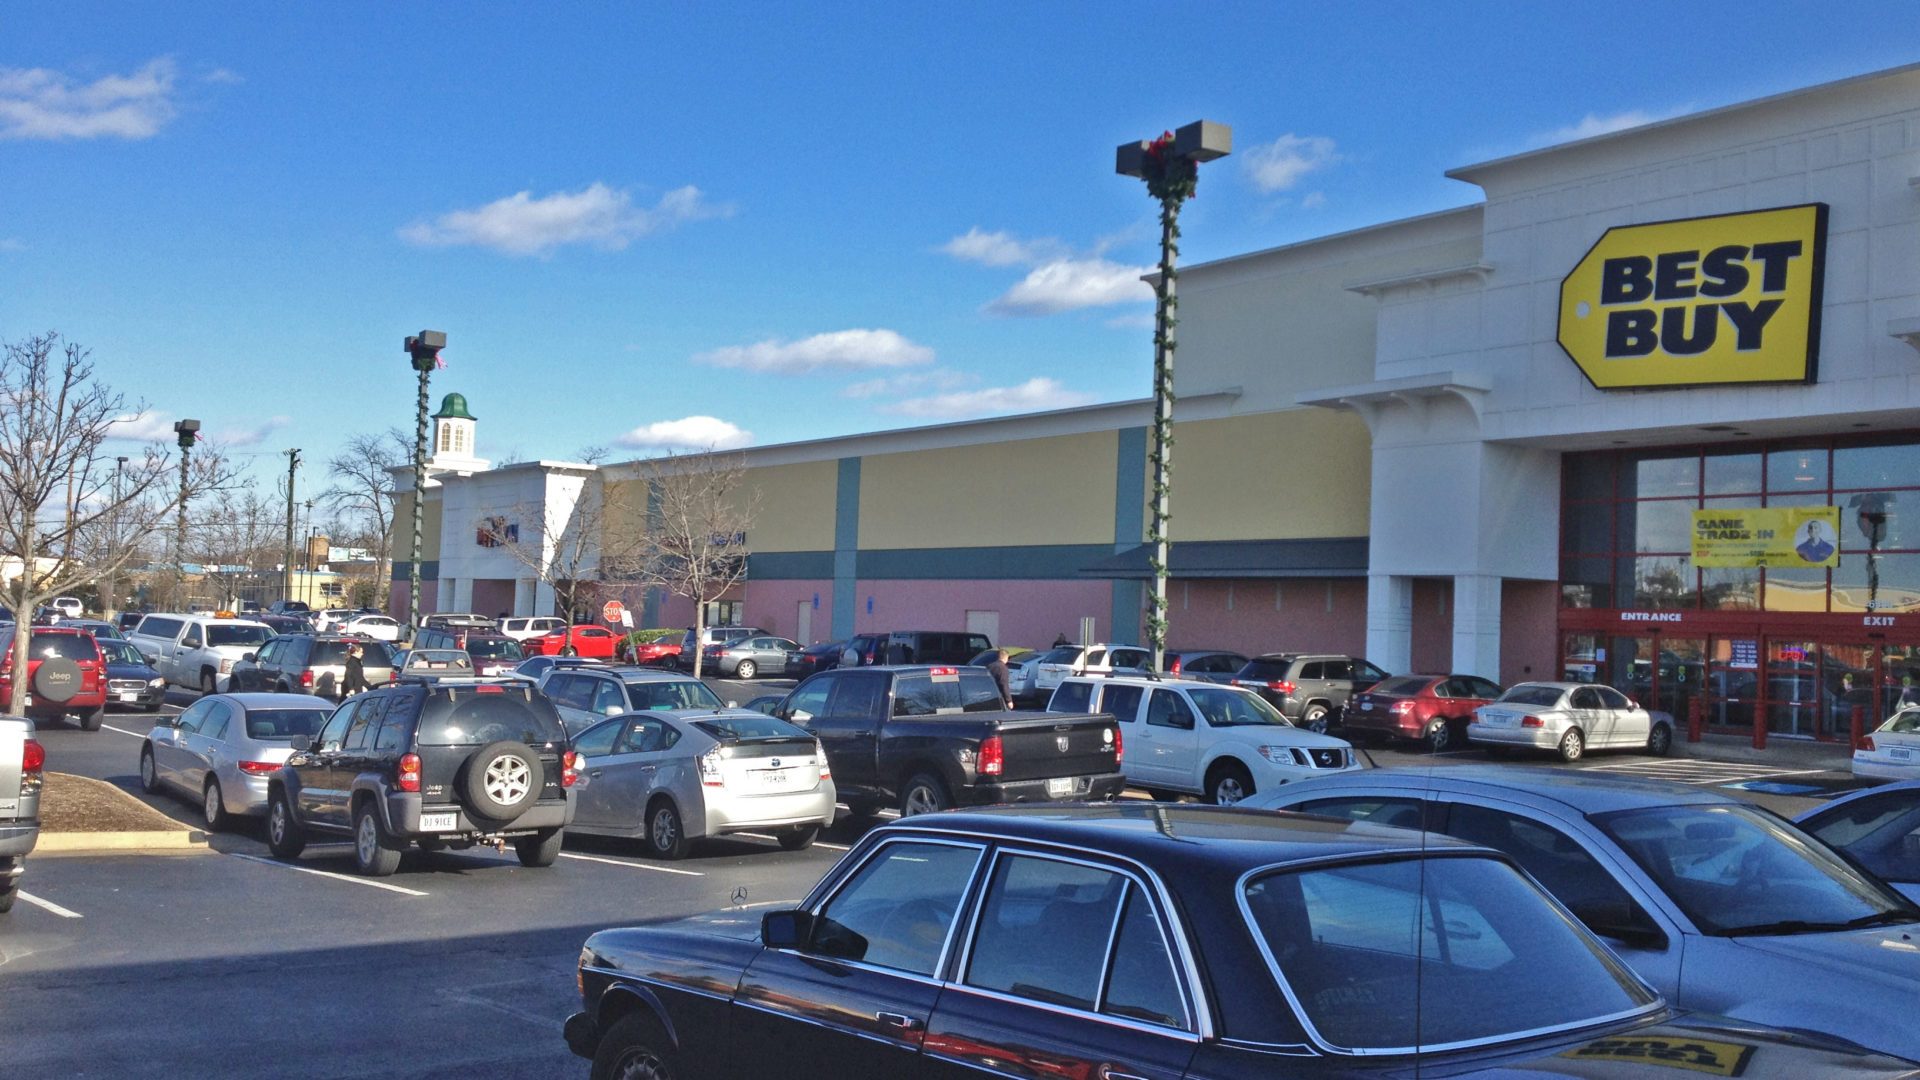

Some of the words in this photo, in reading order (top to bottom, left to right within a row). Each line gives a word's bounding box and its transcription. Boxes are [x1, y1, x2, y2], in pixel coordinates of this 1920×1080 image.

[1600, 240, 1802, 306] BEST
[1605, 299, 1786, 360] BUY
[1697, 519, 1744, 529] GAME
[1621, 612, 1682, 622] ENTRANCE
[1863, 616, 1895, 626] EXIT
[49, 672, 71, 681] Jeep
